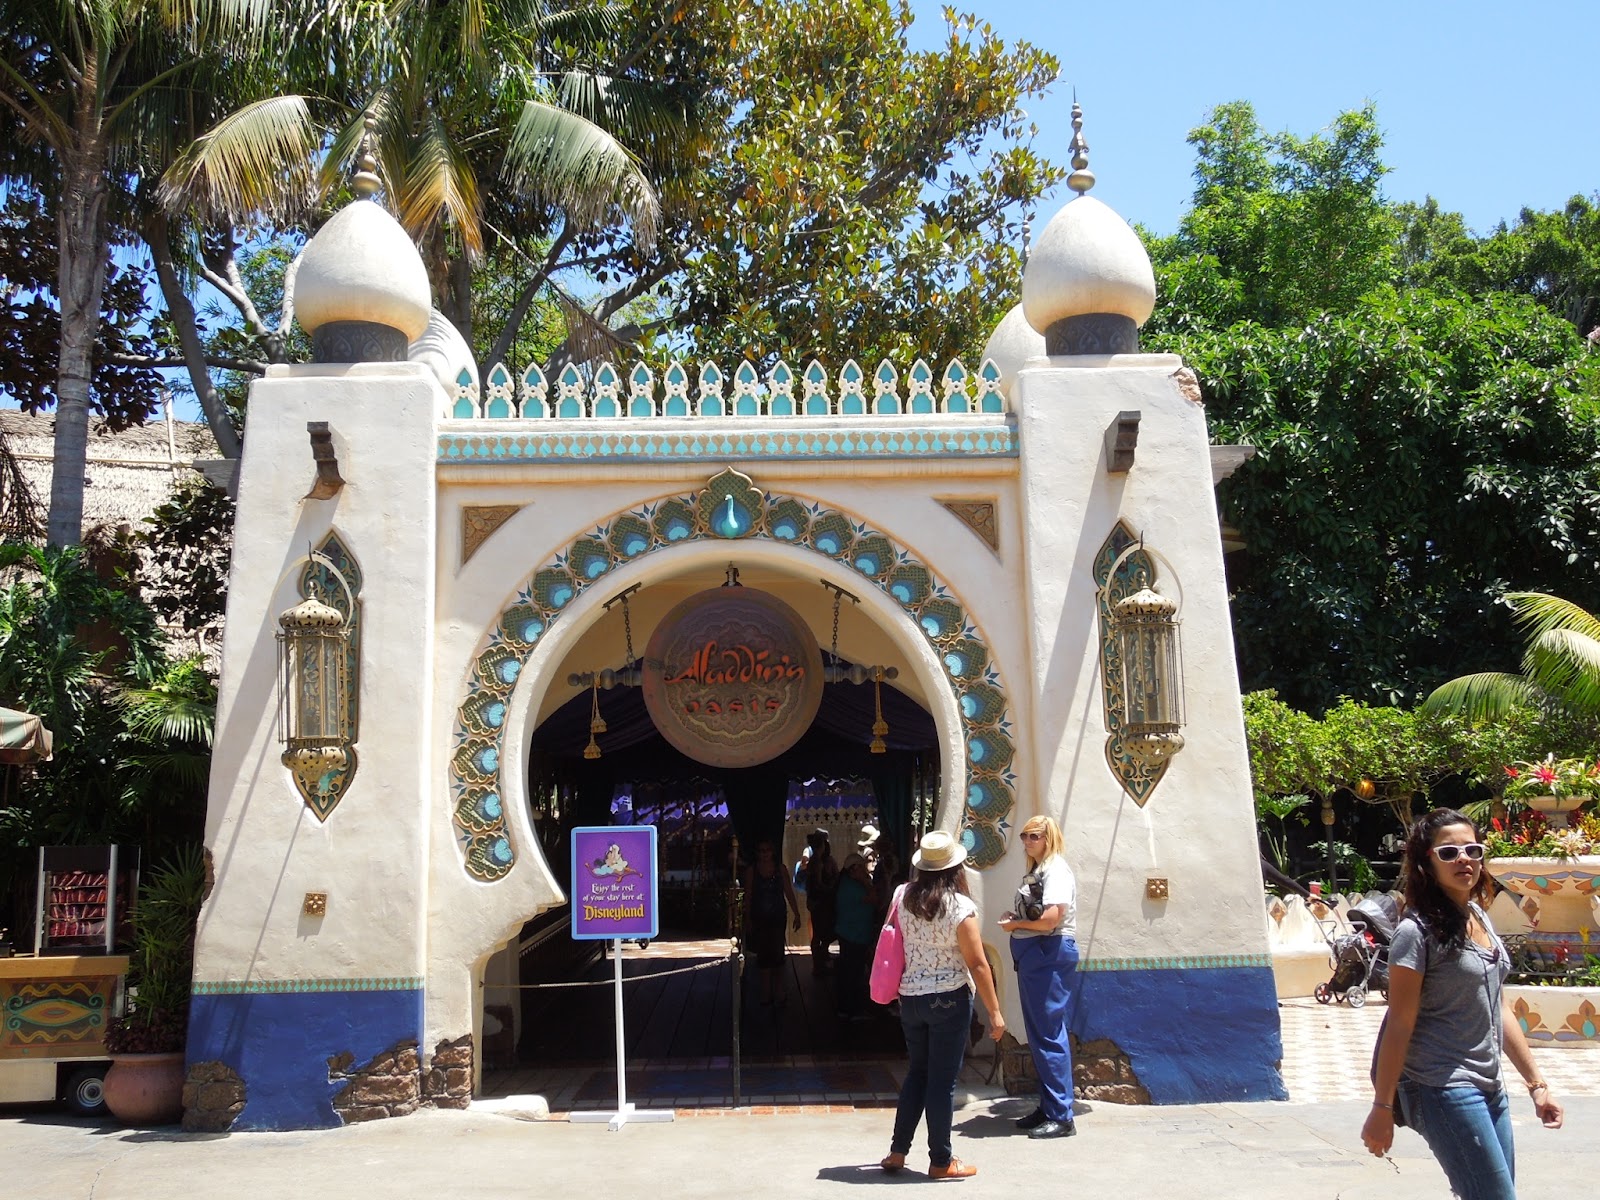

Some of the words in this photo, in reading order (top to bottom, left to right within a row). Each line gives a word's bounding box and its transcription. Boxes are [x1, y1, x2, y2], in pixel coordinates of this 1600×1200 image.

[664, 640, 805, 685] Aladdin's
[592, 883, 609, 894] Enjoy
[611, 883, 621, 892] the
[622, 883, 635, 892] rest
[583, 894, 590, 902] of
[590, 894, 605, 904] your
[607, 893, 620, 903] stay
[622, 892, 634, 901] here
[583, 904, 645, 921] Disneyland
